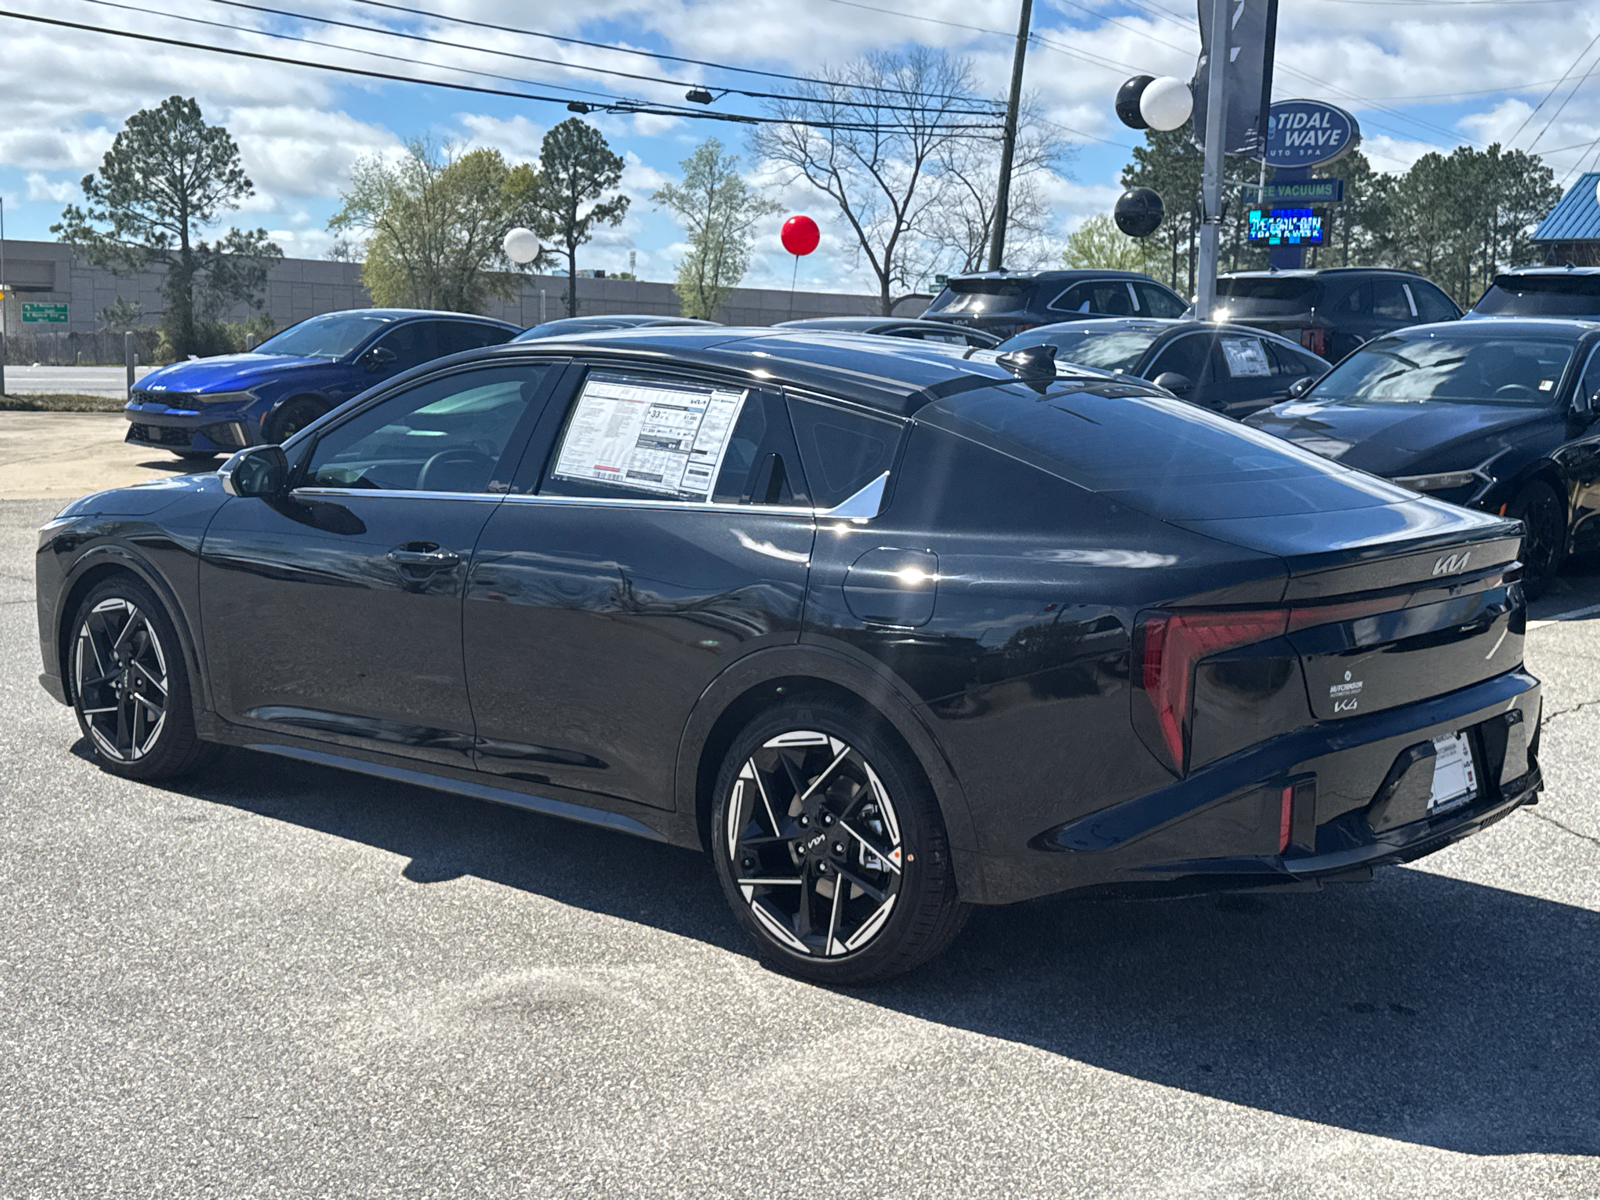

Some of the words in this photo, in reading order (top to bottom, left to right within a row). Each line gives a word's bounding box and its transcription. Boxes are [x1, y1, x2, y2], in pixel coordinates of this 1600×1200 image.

[1277, 112, 1332, 129] TIDAL
[1284, 129, 1342, 147] WAVE
[1267, 149, 1291, 157] UTO
[1278, 183, 1333, 196] VACUUMS
[1431, 551, 1471, 576] KIA
[1334, 697, 1358, 713] K4
